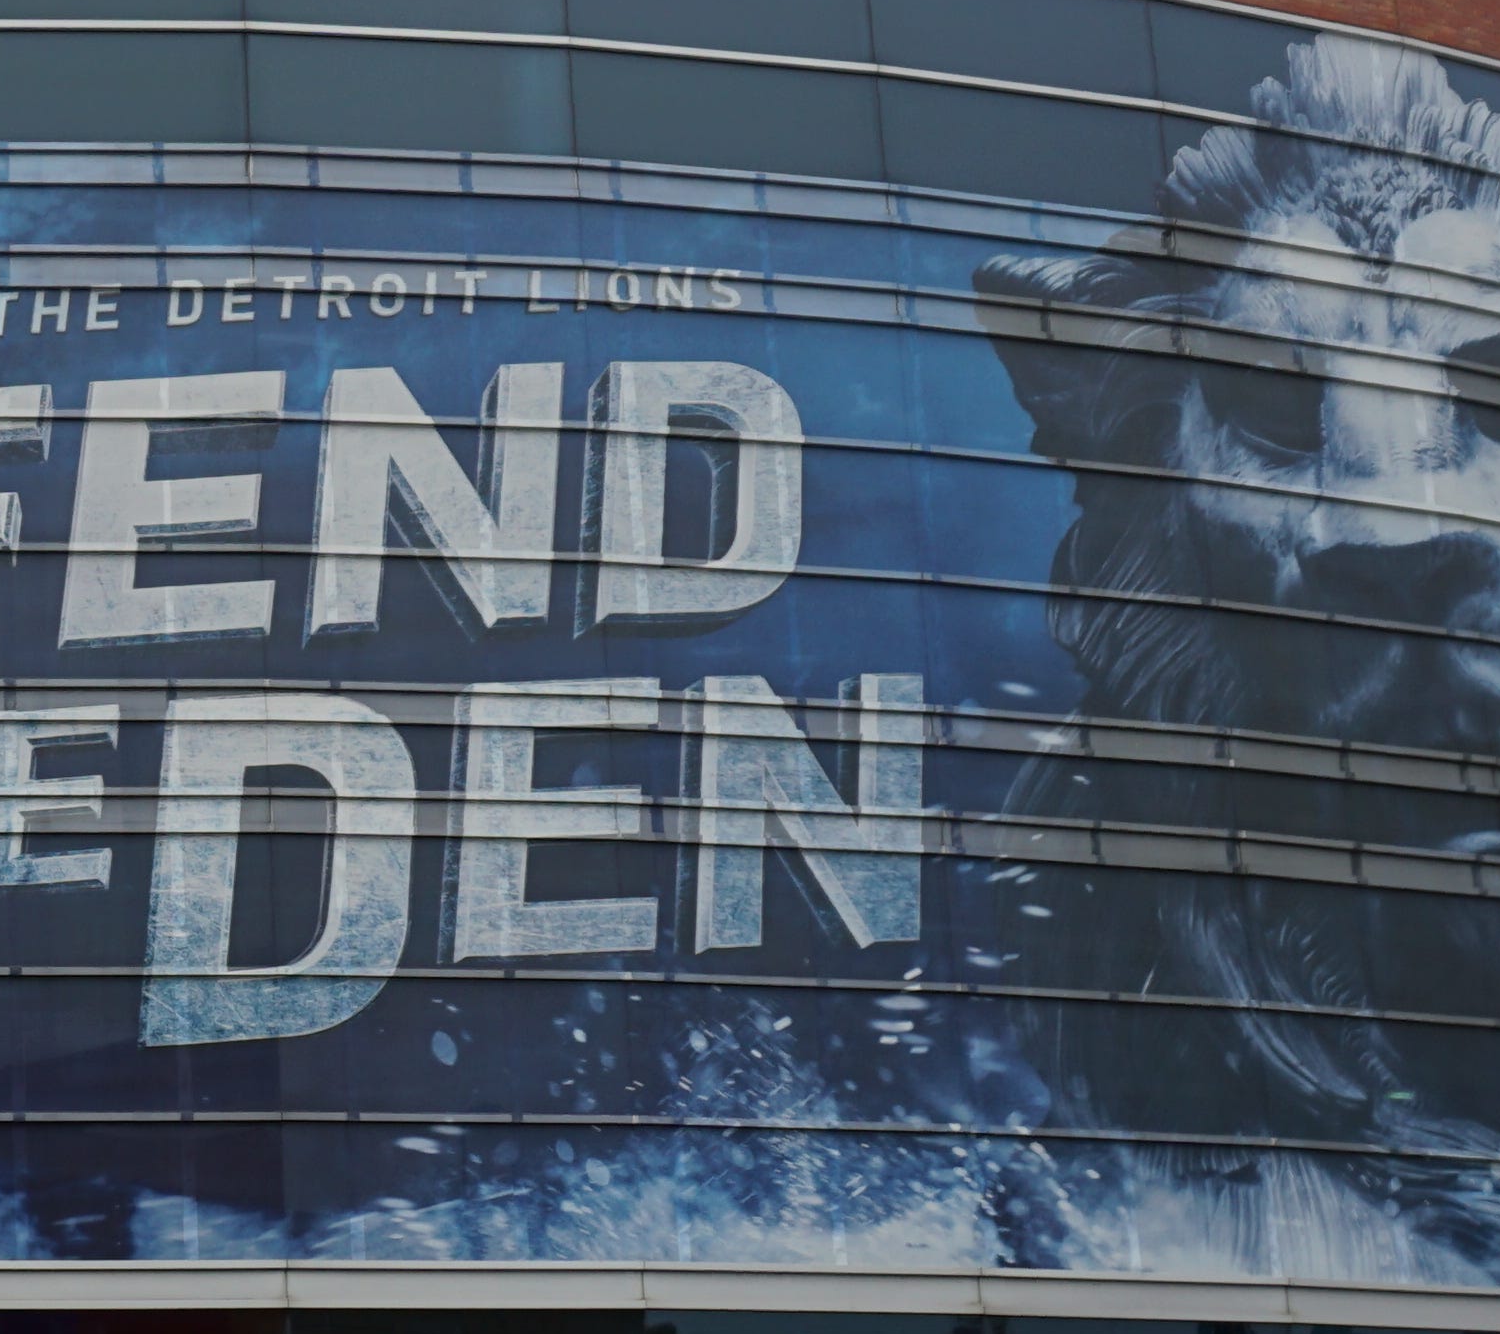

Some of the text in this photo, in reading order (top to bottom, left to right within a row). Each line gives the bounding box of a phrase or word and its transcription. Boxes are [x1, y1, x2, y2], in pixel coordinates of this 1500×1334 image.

[165, 269, 487, 327] DETROIT
[527, 267, 743, 314] LIONS
[136, 671, 928, 1048] DEN
